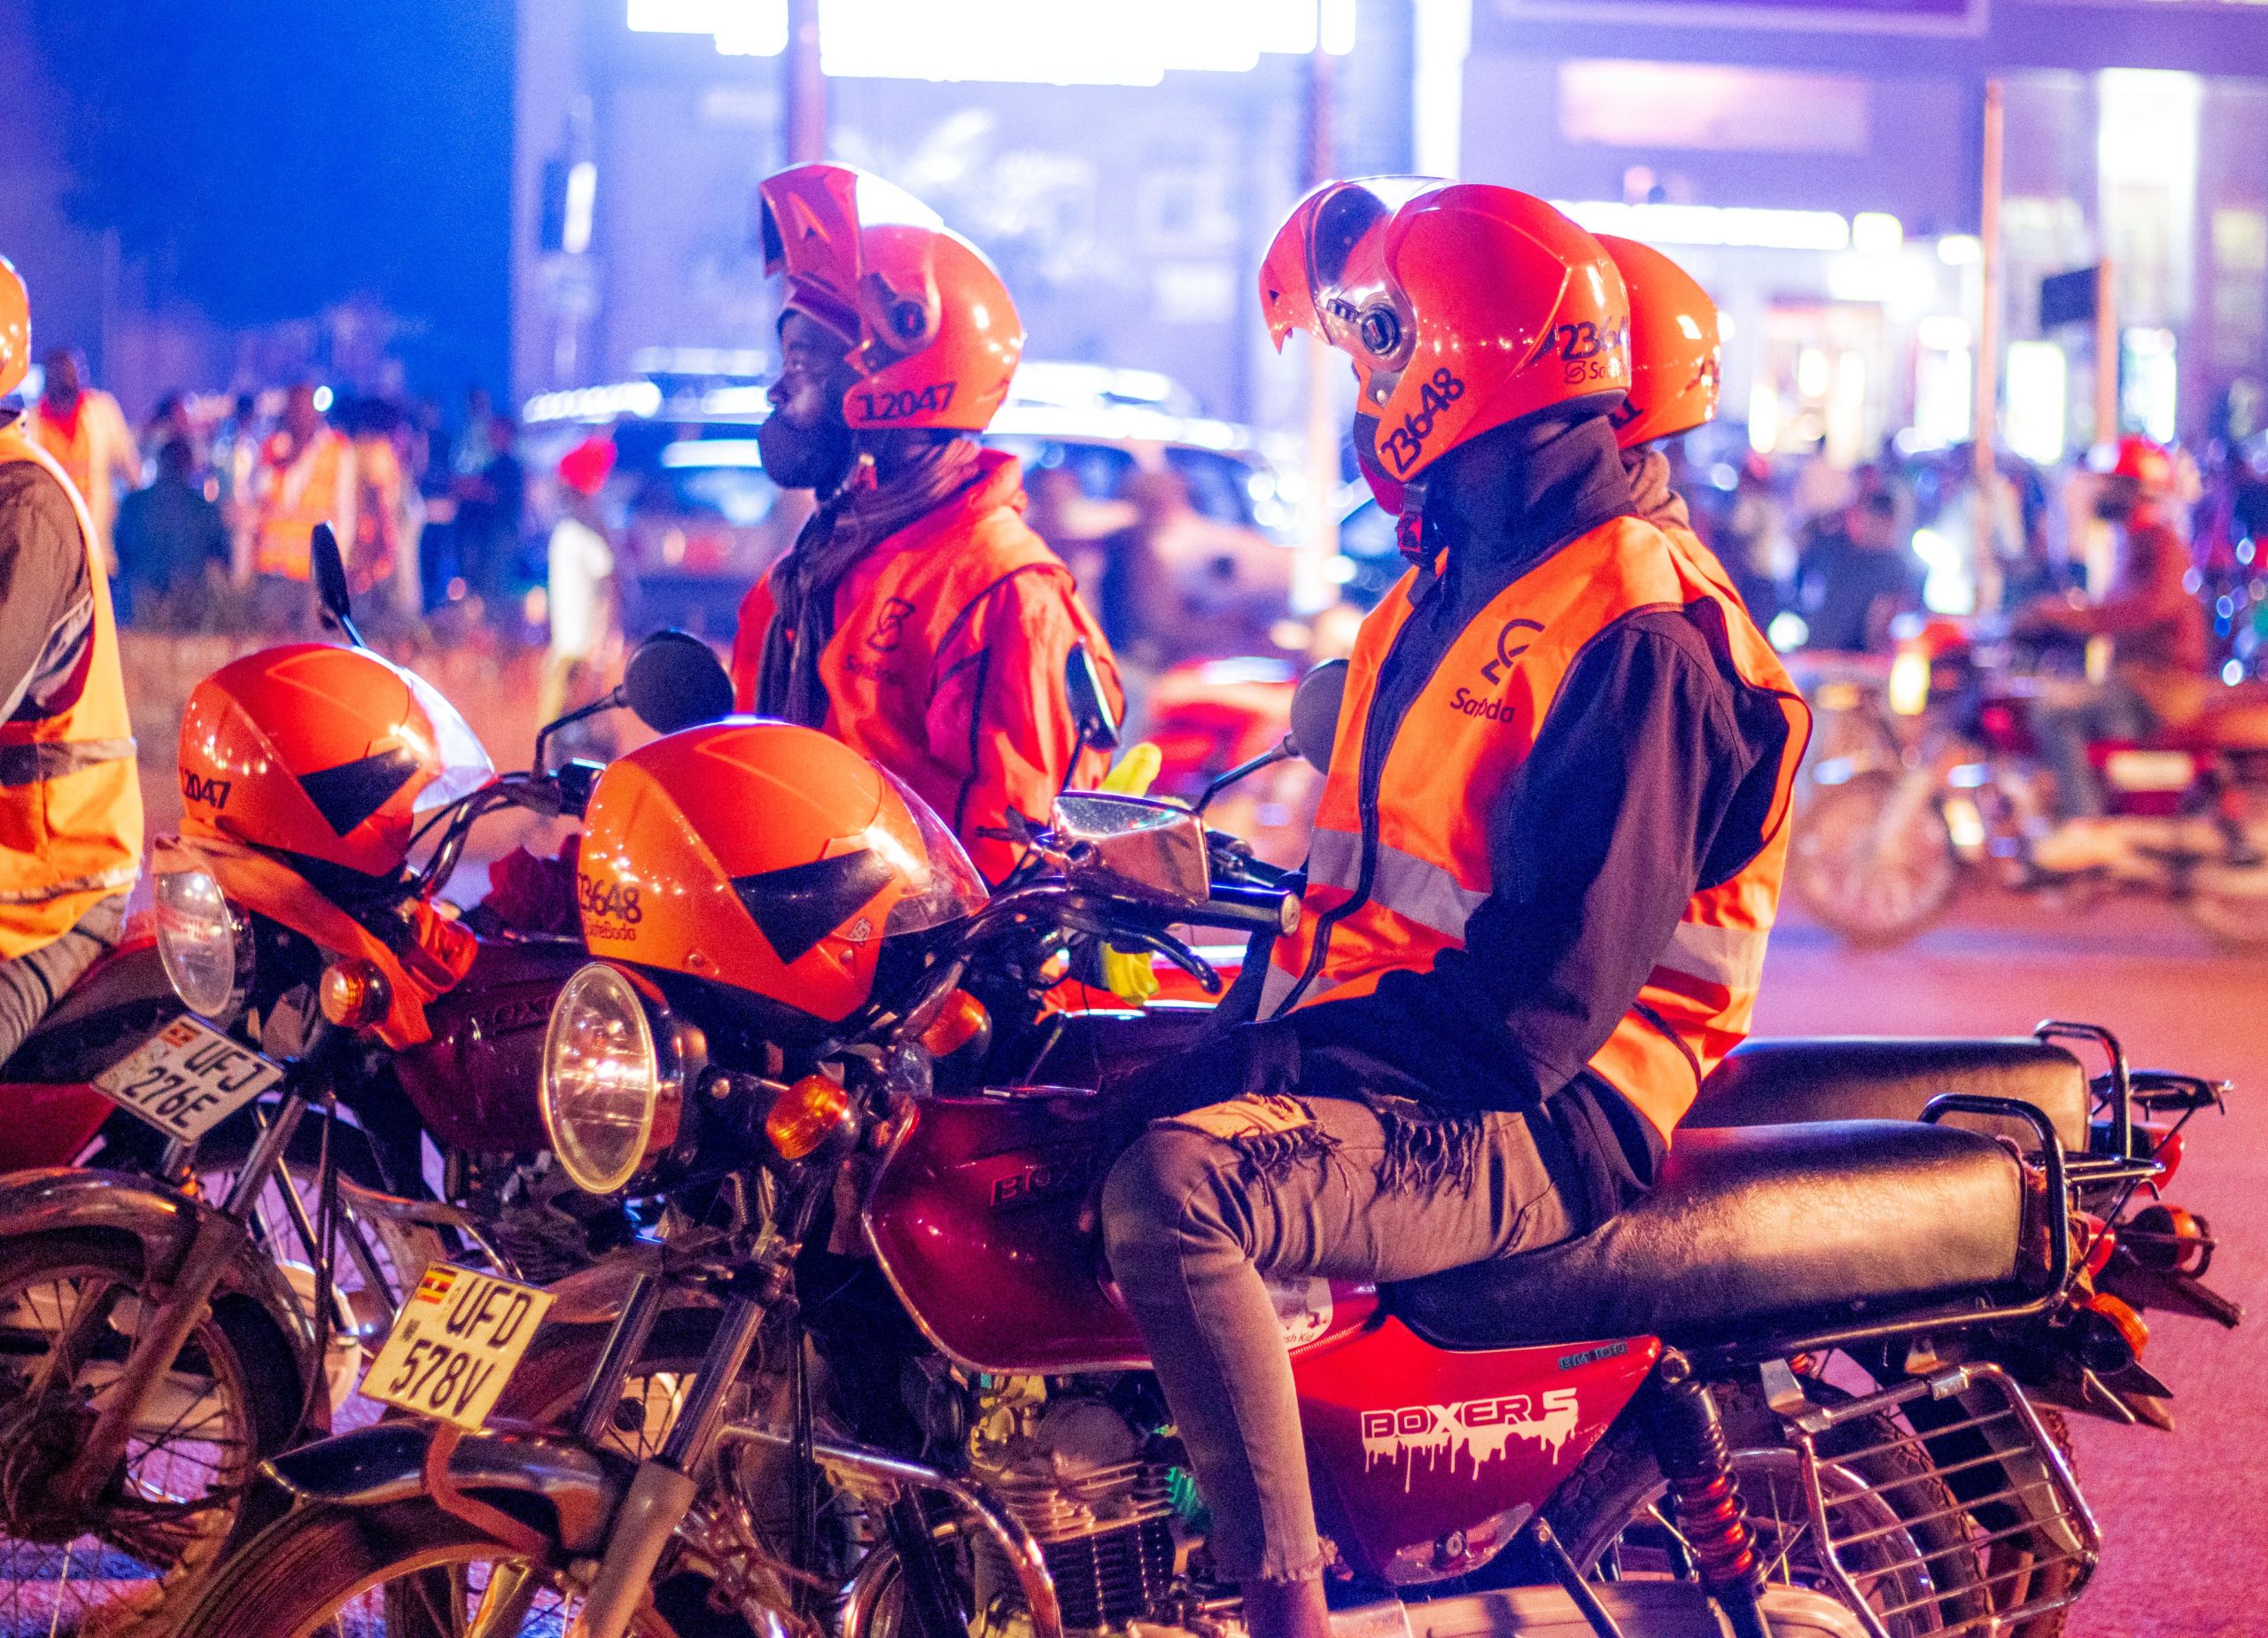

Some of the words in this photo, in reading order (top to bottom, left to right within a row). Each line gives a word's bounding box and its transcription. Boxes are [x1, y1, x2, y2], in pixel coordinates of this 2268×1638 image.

[858, 381, 957, 422] 12047
[1380, 367, 1465, 474] 23648
[121, 1066, 220, 1129] 276E
[183, 1040, 265, 1092] UFJ
[446, 1277, 533, 1349] UFD
[388, 1339, 496, 1418] 578V
[1361, 1393, 1533, 1451] BOXER
